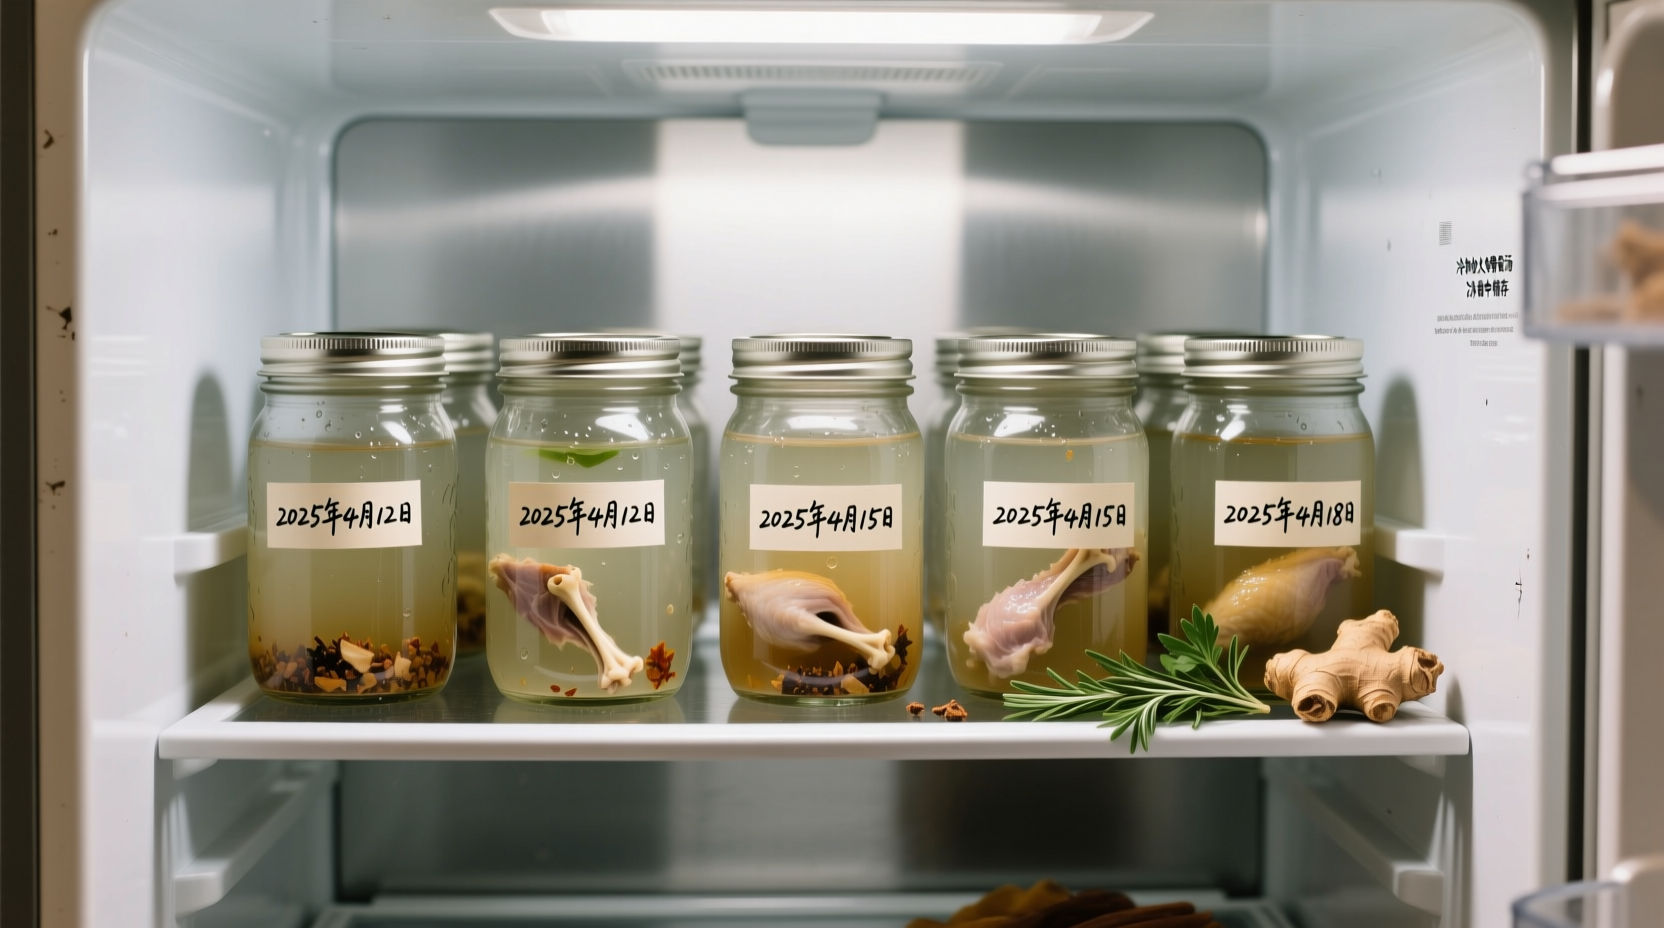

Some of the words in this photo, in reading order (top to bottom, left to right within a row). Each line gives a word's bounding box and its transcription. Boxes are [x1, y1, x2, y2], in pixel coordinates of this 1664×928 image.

[276, 497, 411, 536] 2025年4月12日
[519, 497, 655, 536] 2025年4月12日
[759, 500, 893, 539] 2025年4月15日
[993, 497, 1126, 536] 2025年4月15日
[1223, 496, 1354, 534] 2025年4月18日
